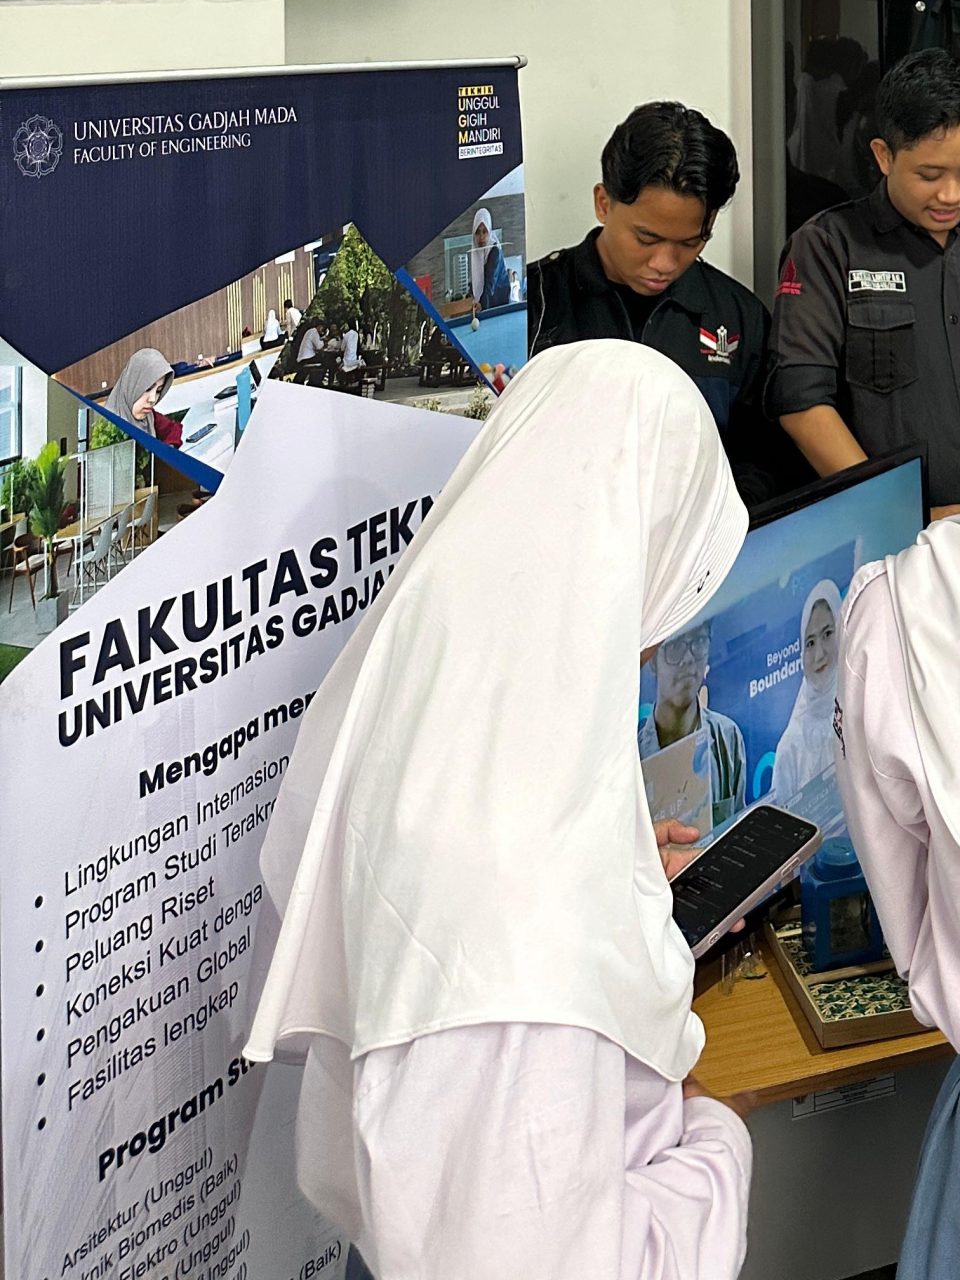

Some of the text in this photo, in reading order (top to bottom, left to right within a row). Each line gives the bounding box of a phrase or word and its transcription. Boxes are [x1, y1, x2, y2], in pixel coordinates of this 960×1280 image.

[74, 106, 298, 141] UNIVERSITAS GADJAH MADA
[458, 96, 500, 111] UNGGUL
[458, 112, 487, 128] GIGIH
[459, 86, 493, 96] TEKNIK
[74, 132, 251, 164] FACULTY OF ENGINEERING
[458, 127, 501, 145] MANDIRI
[460, 144, 502, 157] BERINTEGRITAS
[58, 564, 395, 748] UNIVERSITAS GADJA
[59, 536, 339, 700] FAKULTAS
[767, 637, 800, 667] Beyond
[139, 717, 259, 799] Mengapa
[64, 870, 157, 940] Program
[165, 833, 217, 881] Studi
[65, 814, 189, 897] Lingkungan
[65, 876, 215, 983] Peluang Riset
[66, 883, 264, 1026] Koneksi Kuat denga
[67, 925, 251, 1069] Pengakuan Global
[68, 981, 239, 1112] Fasilitas lengkap
[98, 1077, 224, 1183] Program
[61, 1146, 214, 1277] Arsitektur (Unggul)
[118, 1196, 196, 1261] Biomedis
[199, 1152, 239, 1204] (Baik)
[175, 1215, 236, 1280] (Unggul)
[182, 1179, 242, 1247] (Unggul)
[300, 1239, 342, 1280] (Baik)
